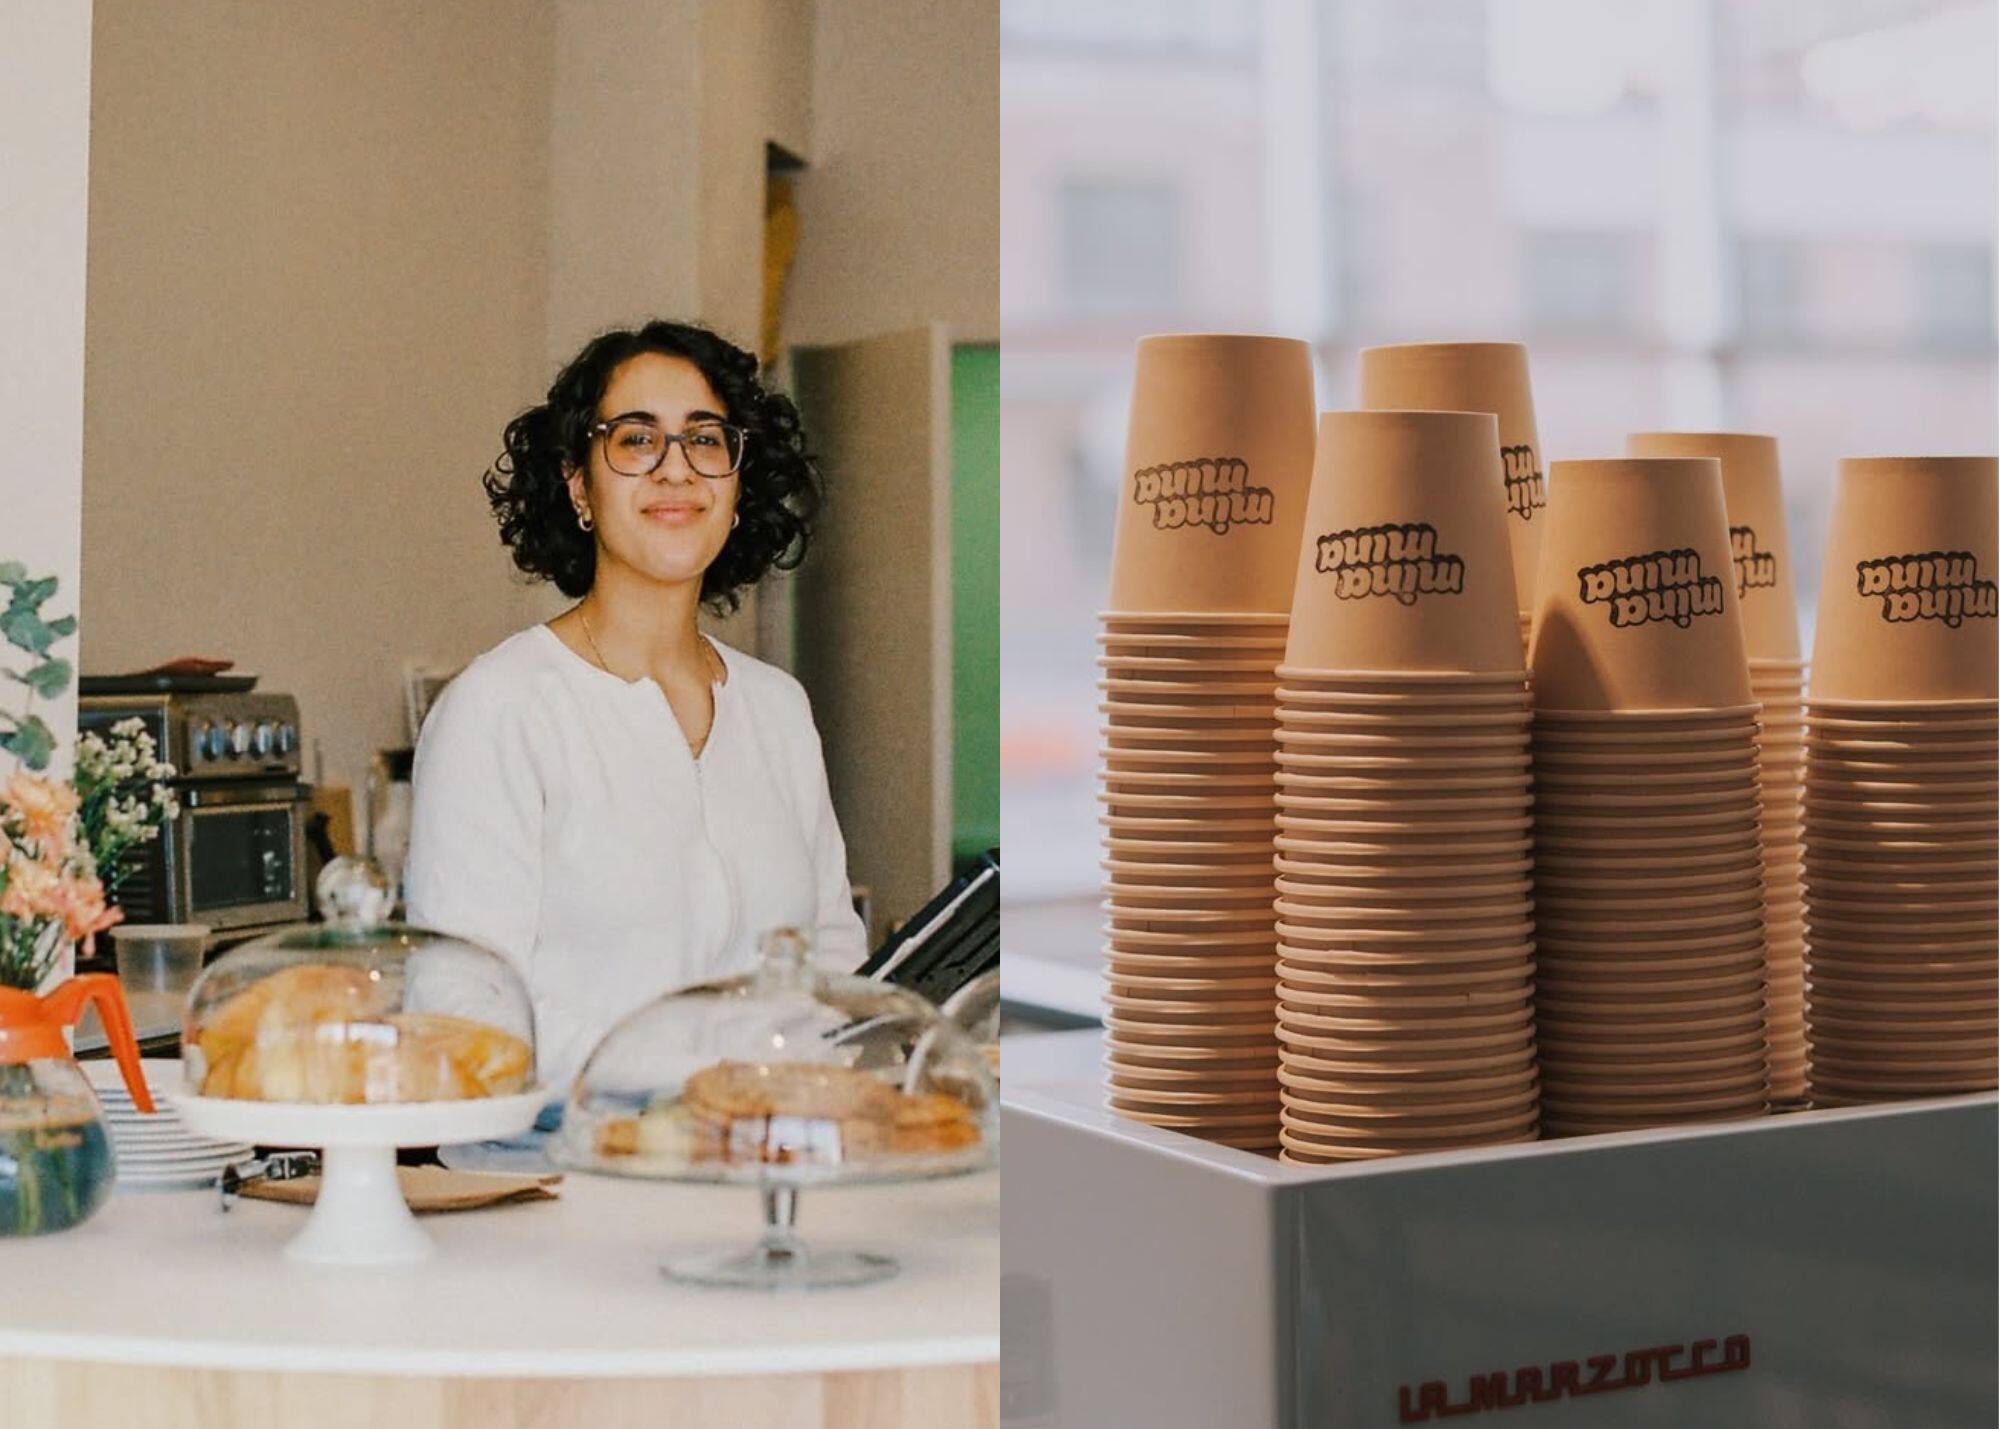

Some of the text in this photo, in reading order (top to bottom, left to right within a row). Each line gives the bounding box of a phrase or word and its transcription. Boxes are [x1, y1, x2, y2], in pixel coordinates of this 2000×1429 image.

[1135, 458, 1248, 504] mina
[1154, 487, 1274, 535] mina
[1316, 523, 1438, 572] mina
[1335, 554, 1464, 606] mina
[1578, 548, 1700, 603] mina
[1857, 551, 1977, 597] mina
[1609, 576, 1724, 628] mina
[1881, 580, 1999, 629] mina
[1468, 1334, 1752, 1410] MARZOCCO
